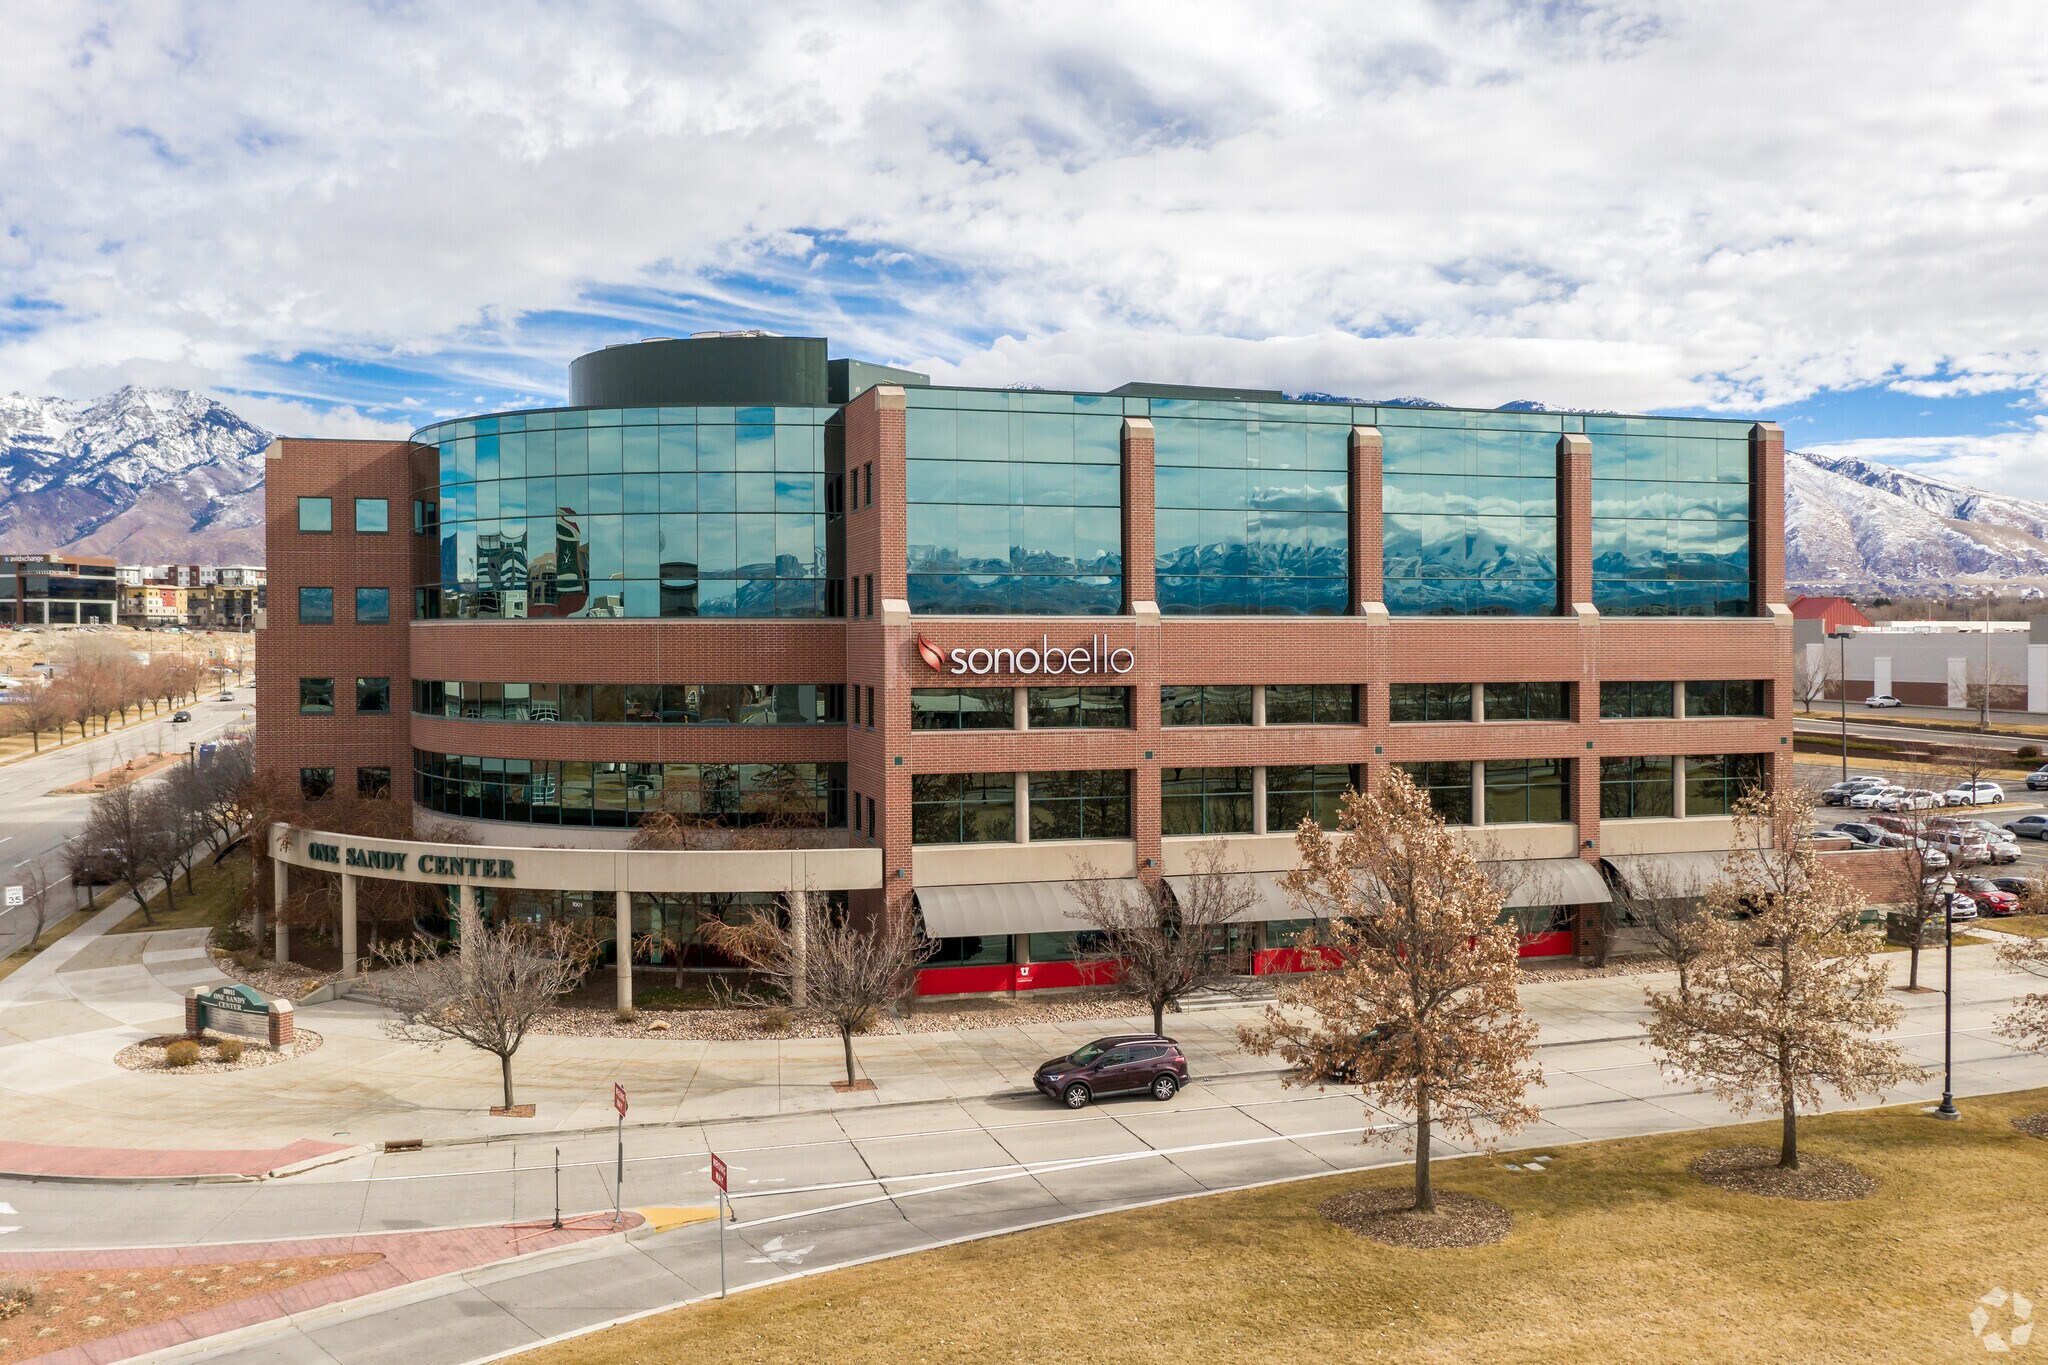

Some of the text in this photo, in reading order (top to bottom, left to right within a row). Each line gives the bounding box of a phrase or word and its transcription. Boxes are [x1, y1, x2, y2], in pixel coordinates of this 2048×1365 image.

[950, 633, 1135, 674] sonobello
[308, 842, 516, 879] ONE SANDY CENTER
[9, 896, 22, 904] 35
[213, 993, 246, 1004] ONE SANDY
[218, 1001, 242, 1011] CENTER
[715, 1171, 724, 1184] WAY
